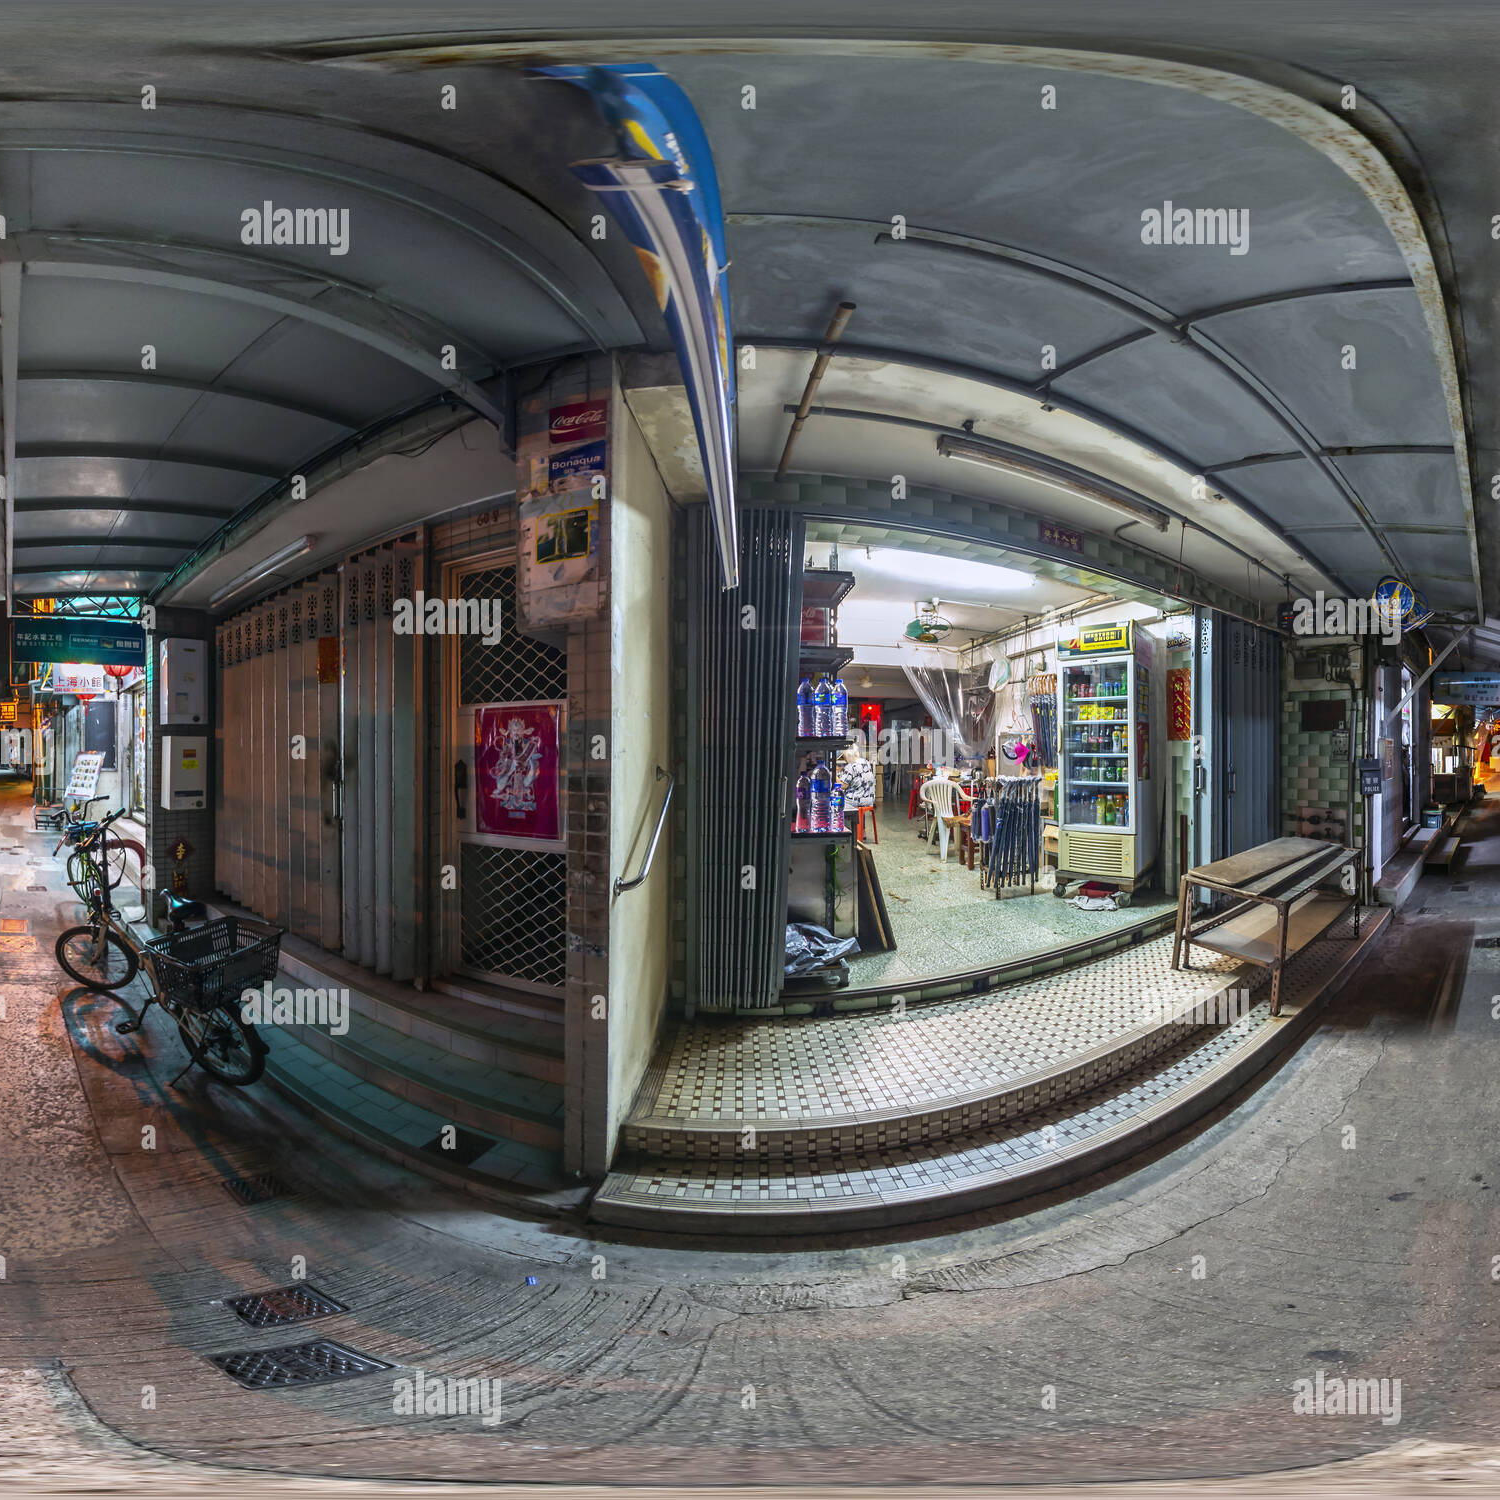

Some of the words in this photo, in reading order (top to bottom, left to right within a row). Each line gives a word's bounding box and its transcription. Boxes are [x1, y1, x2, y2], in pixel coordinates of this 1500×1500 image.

[552, 456, 601, 470] Bonaqua
[1085, 630, 1117, 639] WESTERN
[54, 676, 102, 687] 上海小館
